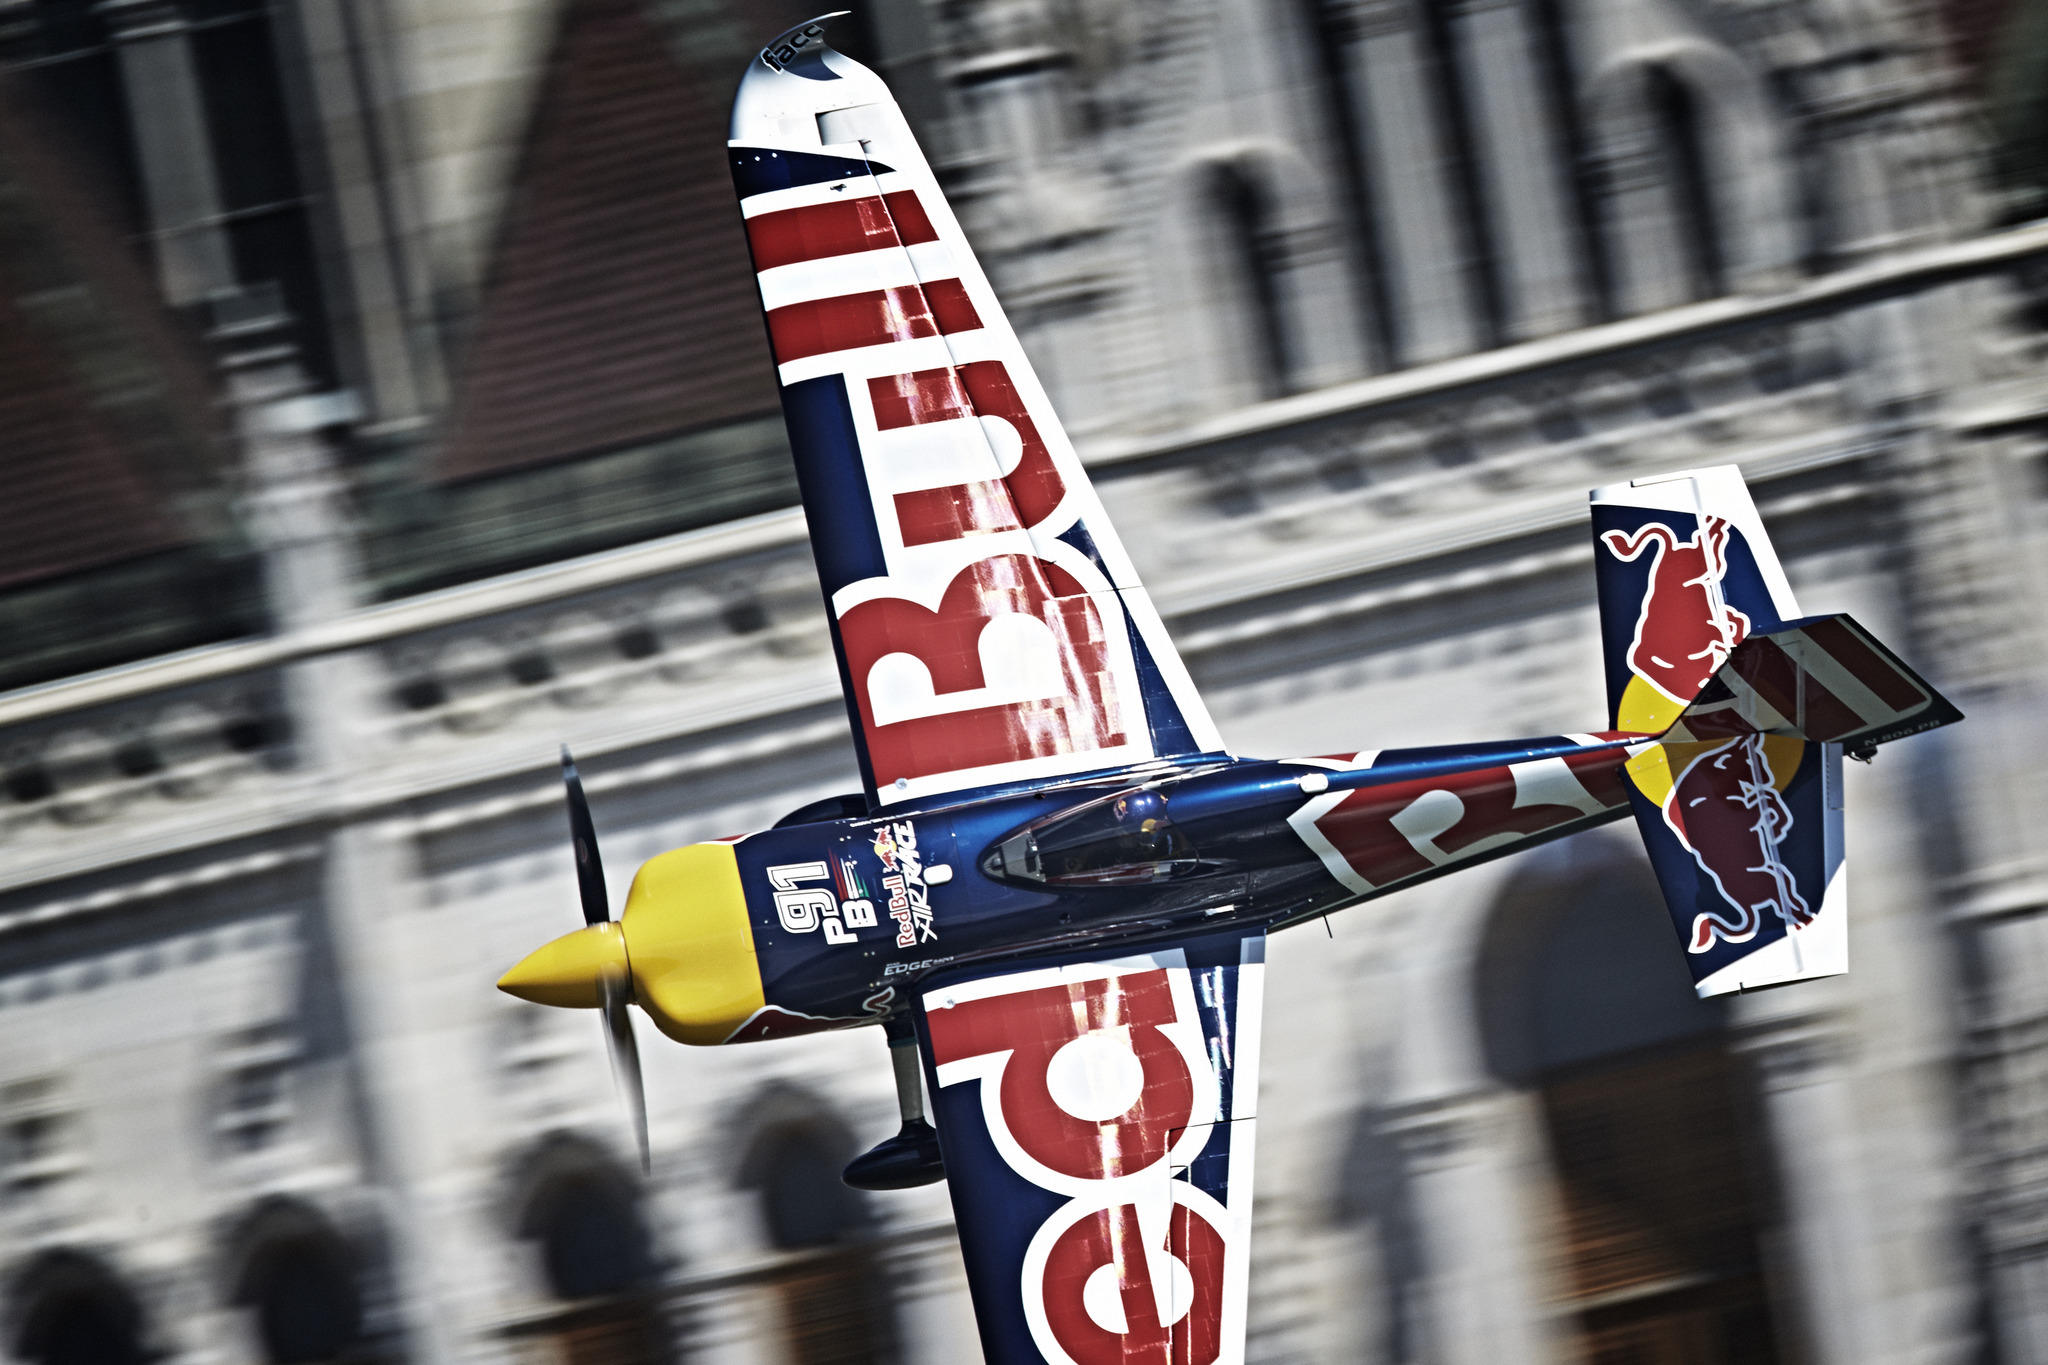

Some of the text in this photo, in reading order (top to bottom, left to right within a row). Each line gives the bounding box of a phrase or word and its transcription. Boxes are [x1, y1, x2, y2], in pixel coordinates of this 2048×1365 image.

[761, 25, 823, 74] facc
[744, 190, 1128, 788] Bull
[893, 820, 924, 886] RACE
[766, 861, 839, 934] 91
[822, 899, 878, 945] PB
[883, 959, 933, 976] EDGE
